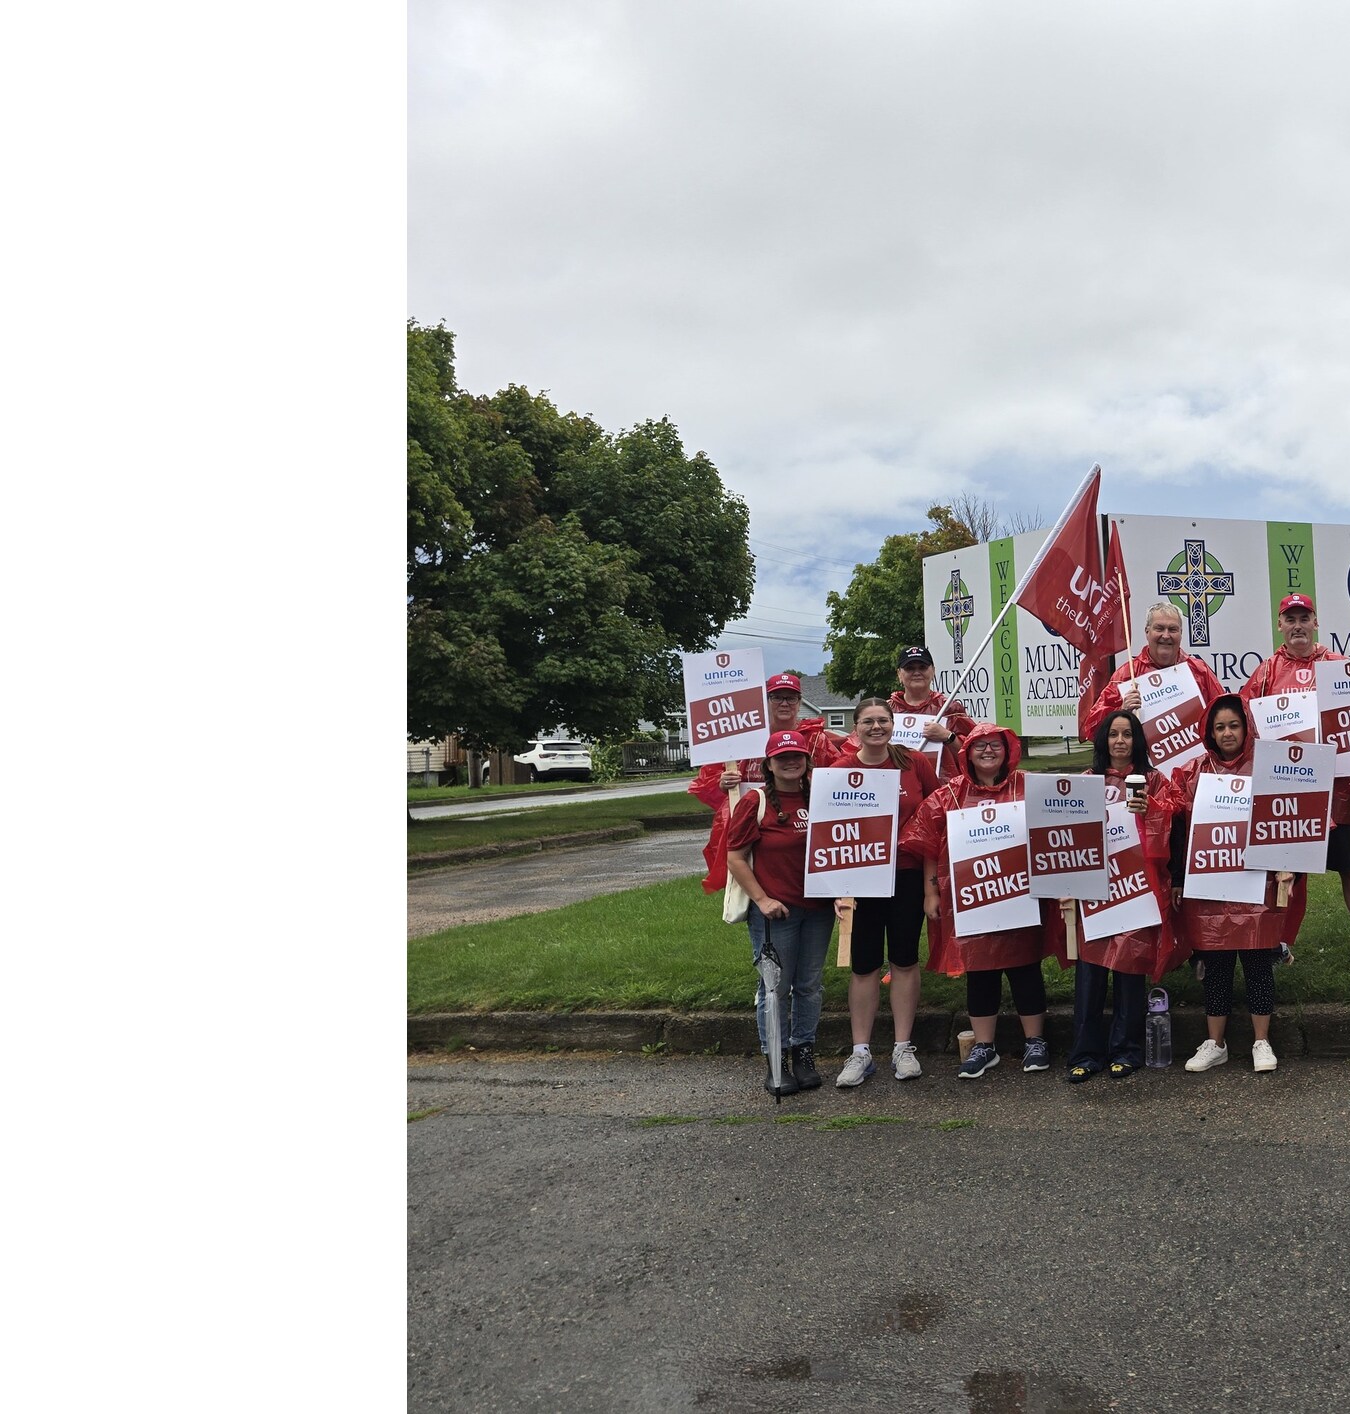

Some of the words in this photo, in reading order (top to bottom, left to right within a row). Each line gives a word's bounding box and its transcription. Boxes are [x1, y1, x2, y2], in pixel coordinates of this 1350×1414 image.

[708, 696, 735, 716] ON
[1027, 704, 1044, 717] EARLY
[1045, 703, 1076, 717] LEARNING
[696, 710, 761, 740] STRIKE
[1155, 711, 1182, 735] ON
[1271, 797, 1298, 817] ON
[831, 822, 860, 843] ON
[1047, 828, 1074, 848] ON
[1211, 825, 1237, 845] ON
[1255, 818, 1322, 841] STRIKE
[814, 841, 886, 868] STRIKE
[1035, 848, 1100, 871] STRIKE
[972, 855, 1002, 879] ON
[960, 871, 1029, 907] STRIKE
